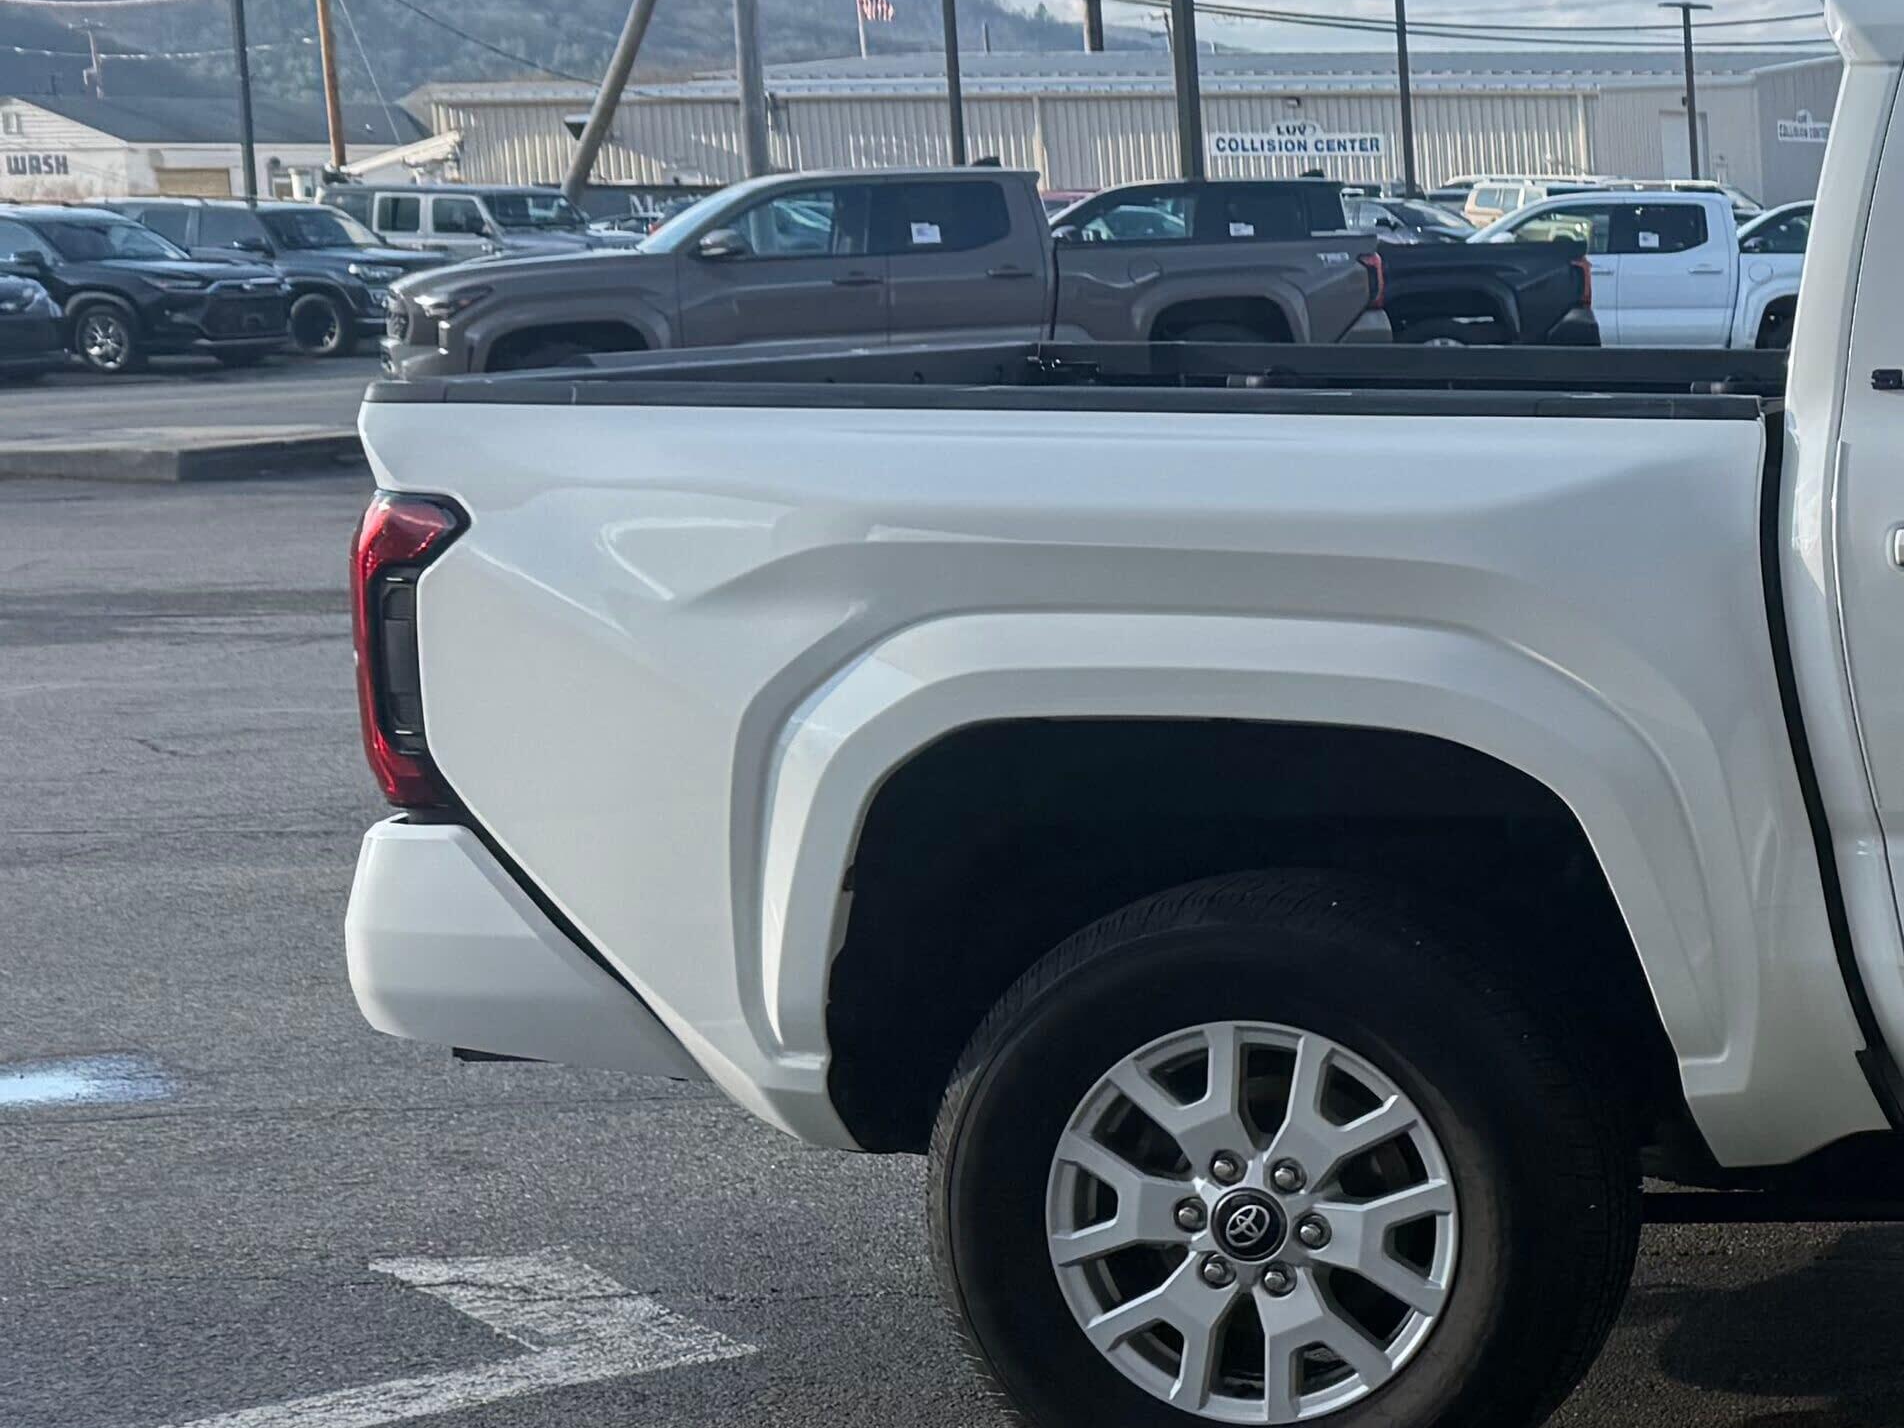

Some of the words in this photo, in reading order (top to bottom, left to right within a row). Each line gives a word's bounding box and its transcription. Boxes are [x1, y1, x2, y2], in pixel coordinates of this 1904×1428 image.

[1216, 137, 1308, 152] COLLISION
[1314, 137, 1380, 152] CENTER
[6, 154, 69, 175] WASH
